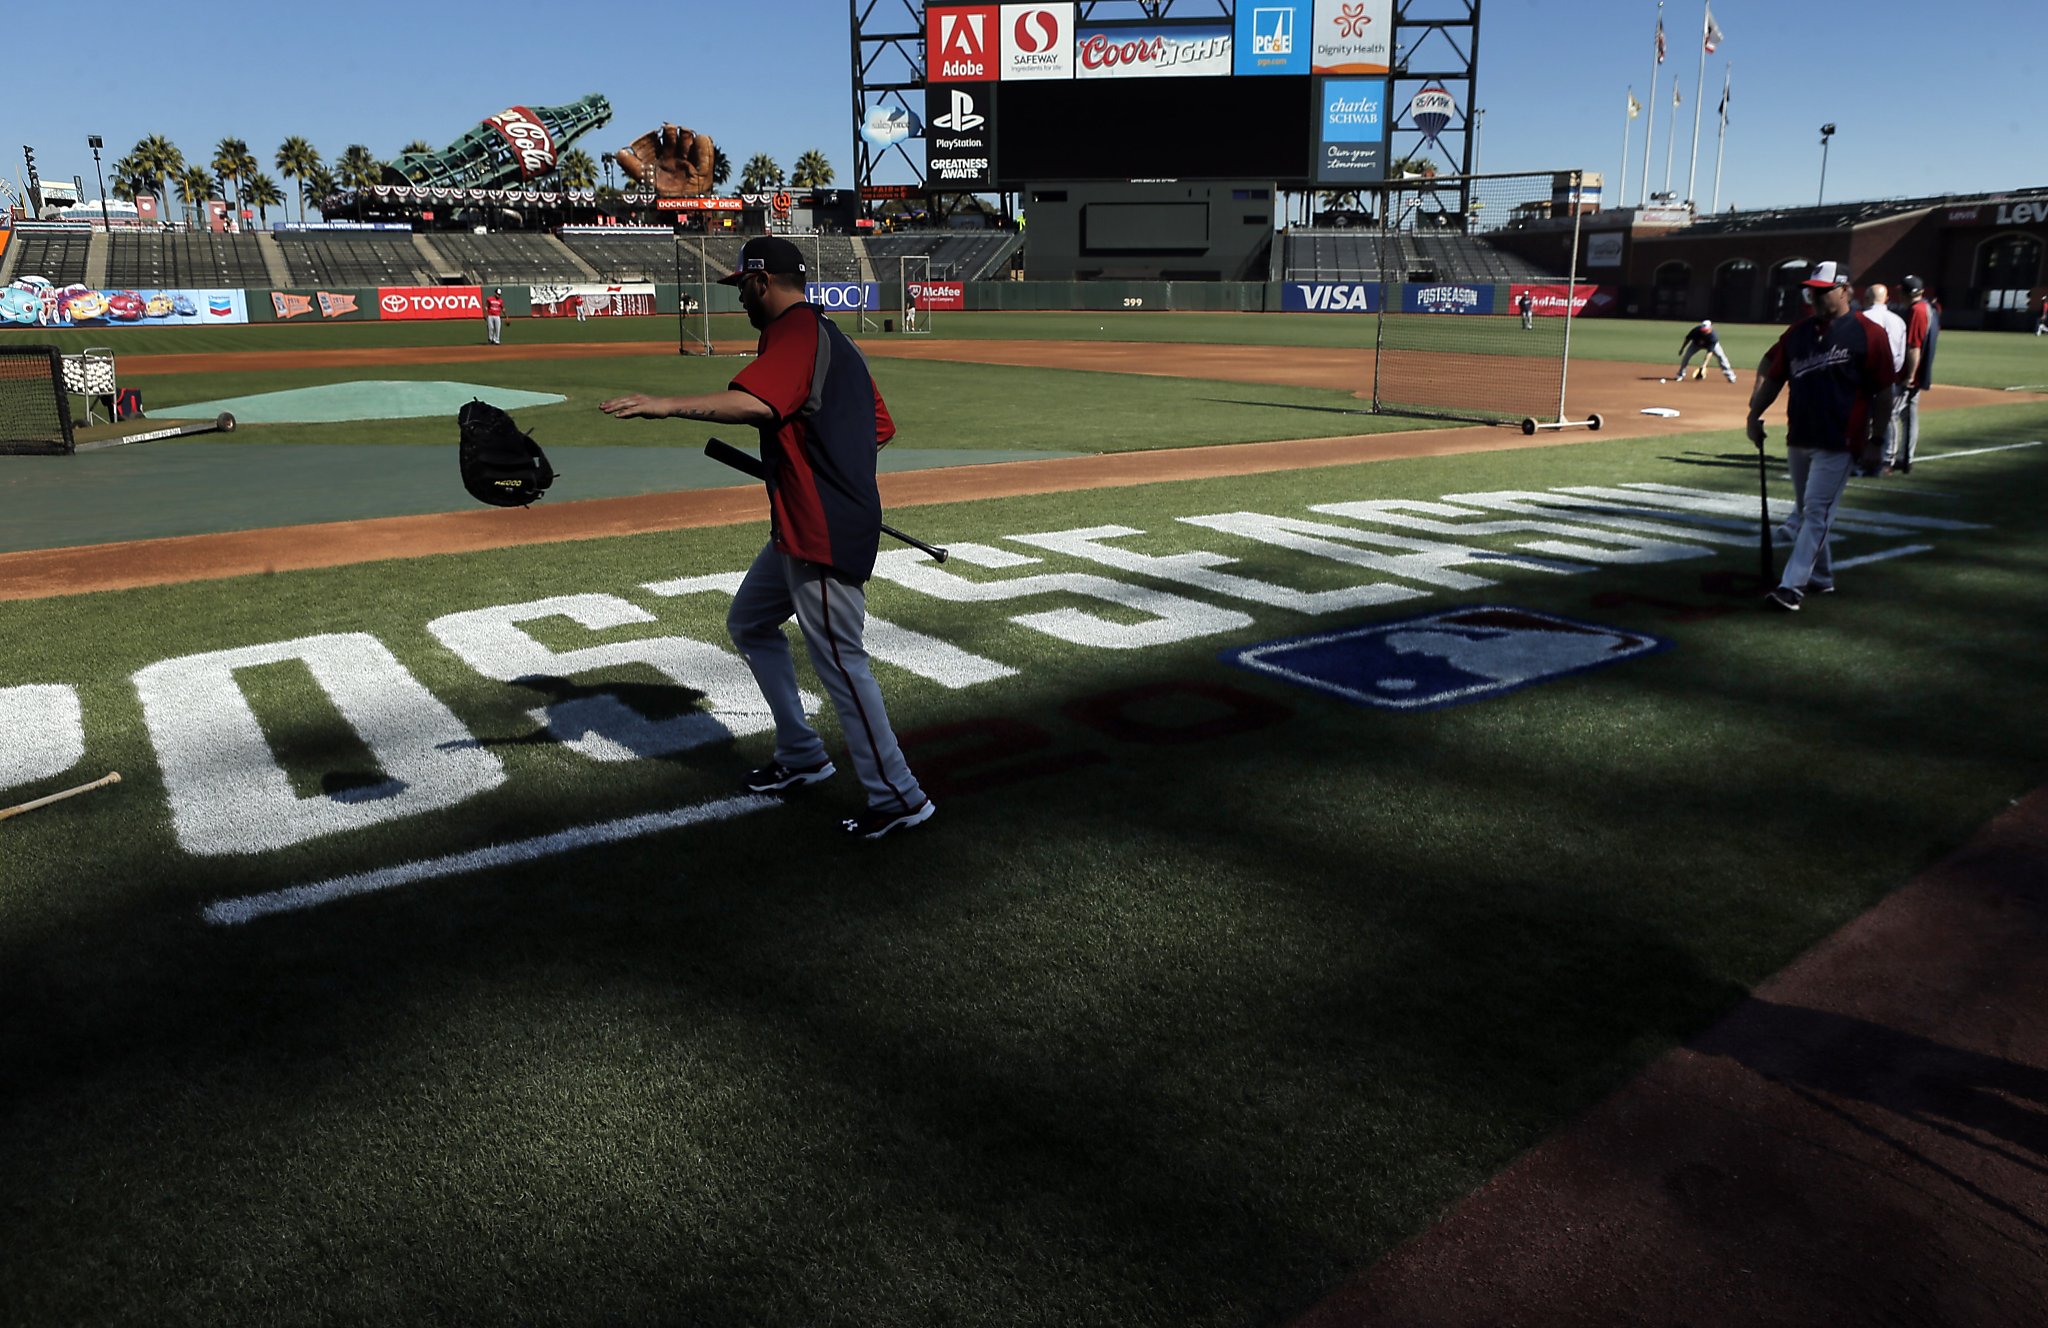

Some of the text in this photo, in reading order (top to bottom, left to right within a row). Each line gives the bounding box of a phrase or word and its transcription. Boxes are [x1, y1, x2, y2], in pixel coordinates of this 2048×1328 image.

[1255, 35, 1290, 51] PG&E
[1318, 43, 1386, 56] Dignity Health
[1079, 34, 1231, 70] Coors LIGHT
[1014, 55, 1058, 65] SAFEWAY
[942, 60, 984, 76] Adobe
[1329, 97, 1378, 113] charles
[1329, 113, 1378, 124] SCHWAB
[936, 139, 982, 150] PlayStation
[1350, 149, 1376, 162] your
[931, 158, 988, 170] GREATNESS
[804, 285, 869, 308] HOO!
[923, 286, 960, 297] McAfee
[1297, 285, 1367, 310] VISA
[1417, 287, 1478, 306] POSTSEASON
[410, 296, 481, 310] TOYOTA
[1123, 297, 1143, 307] 399
[1539, 296, 1549, 306] of
